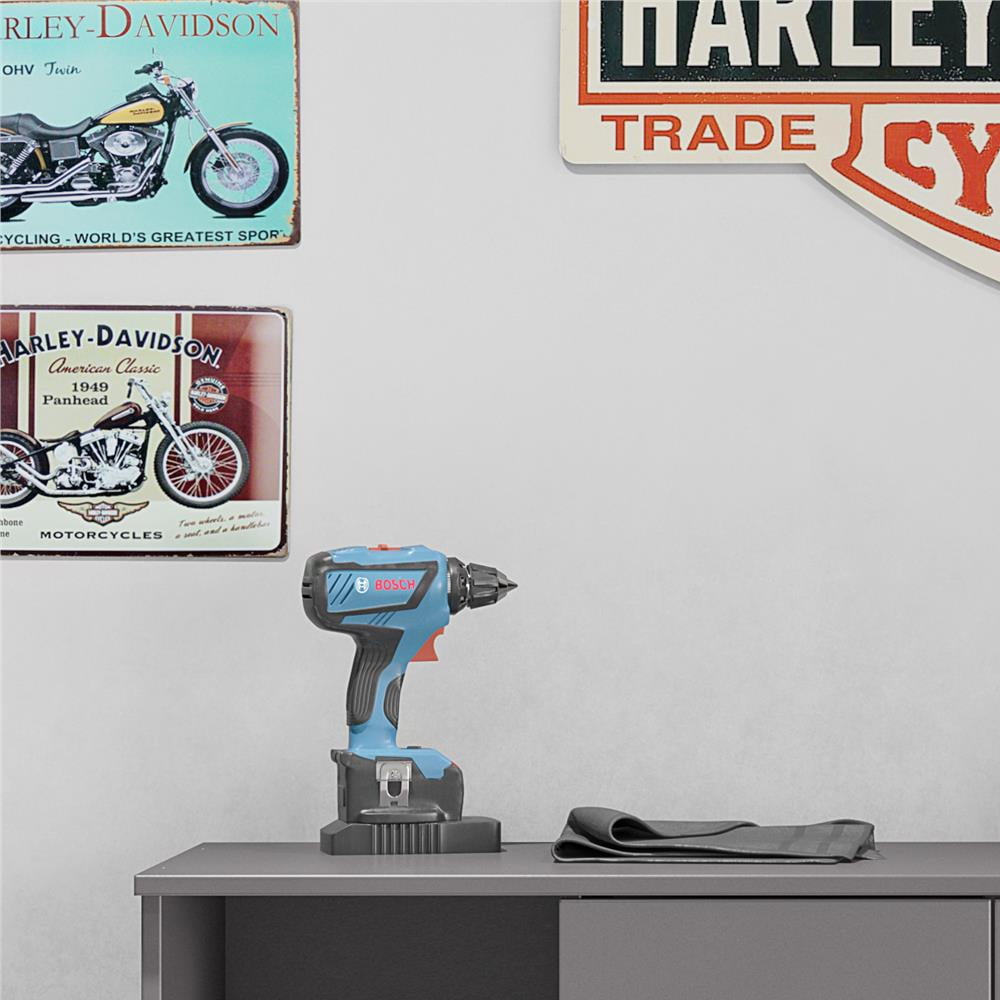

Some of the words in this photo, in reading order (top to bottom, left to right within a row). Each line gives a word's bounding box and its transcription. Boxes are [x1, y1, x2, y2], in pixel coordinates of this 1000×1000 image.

[0, 4, 279, 40] RLEY-DAVIDSON
[2, 64, 34, 76] OHV
[44, 61, 82, 76] Twin
[601, 115, 816, 151] TRADE
[0, 233, 61, 245] YCLING
[74, 232, 147, 243] WORLD'S
[151, 231, 233, 242] GREATEST
[238, 230, 287, 241] SPOR
[48, 357, 112, 374] American
[115, 357, 161, 374] Classic
[72, 382, 109, 392] 1949
[42, 395, 108, 405] Panhead
[40, 531, 163, 540] MOTORCYCLES
[375, 579, 416, 591] BOSCH
